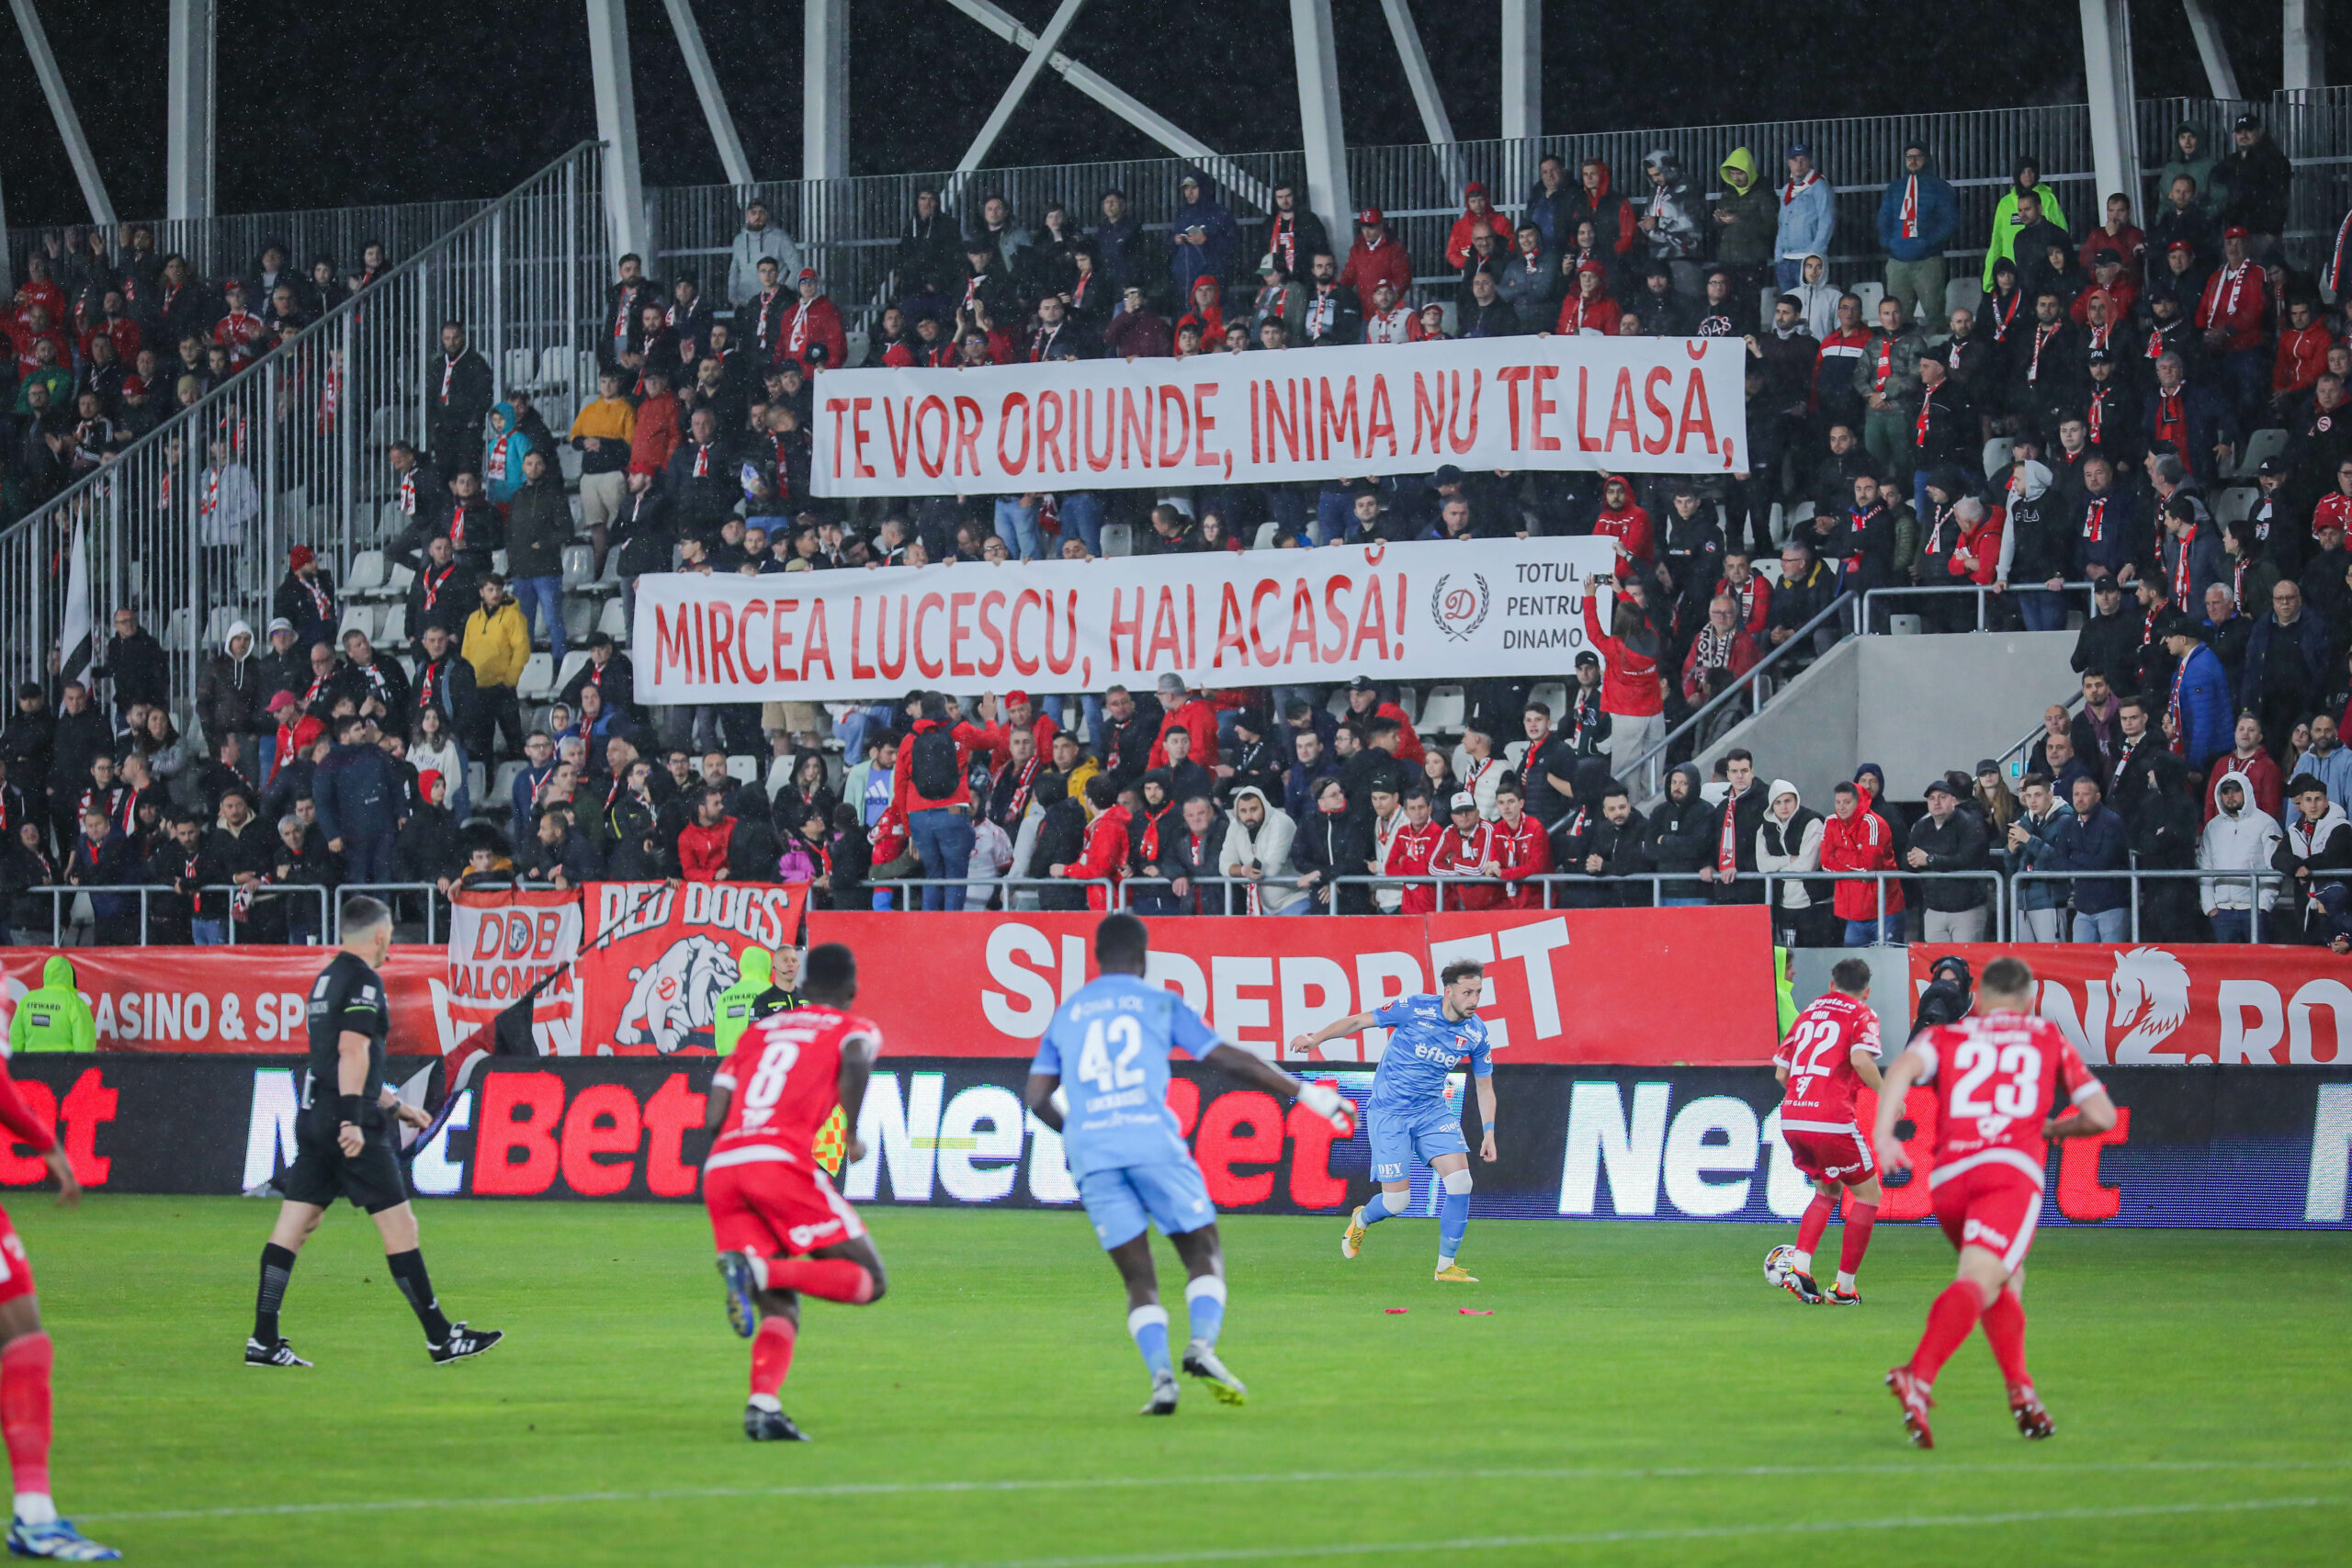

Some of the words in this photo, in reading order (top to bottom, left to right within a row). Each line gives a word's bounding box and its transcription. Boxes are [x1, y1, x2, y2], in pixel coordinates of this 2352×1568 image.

[825, 395, 876, 479] TE
[883, 394, 983, 479] VOR
[997, 382, 1233, 481] ORIUNDE,
[1250, 373, 1397, 464] INIMA
[1411, 368, 1482, 456] NU
[1495, 365, 1562, 452] TE
[1577, 339, 1735, 470] LASĂ,
[1515, 562, 1580, 583] TOTUL
[653, 596, 835, 685] MIRCEA
[851, 588, 1091, 689] LUCESCU,
[1110, 583, 1195, 671] HAI
[1212, 546, 1408, 669] ACASĂ!
[1506, 595, 1584, 616] PENTRU
[1503, 627, 1583, 649] DINAMO
[472, 910, 561, 961] DDB
[596, 883, 676, 950] RED
[683, 881, 790, 953] DOGS
[78, 992, 210, 1042] ASINO
[219, 992, 247, 1042] &
[1790, 1020, 1841, 1077] 22
[743, 1040, 800, 1109] 8
[1078, 1014, 1146, 1093] 42
[1949, 1039, 2042, 1119] 23
